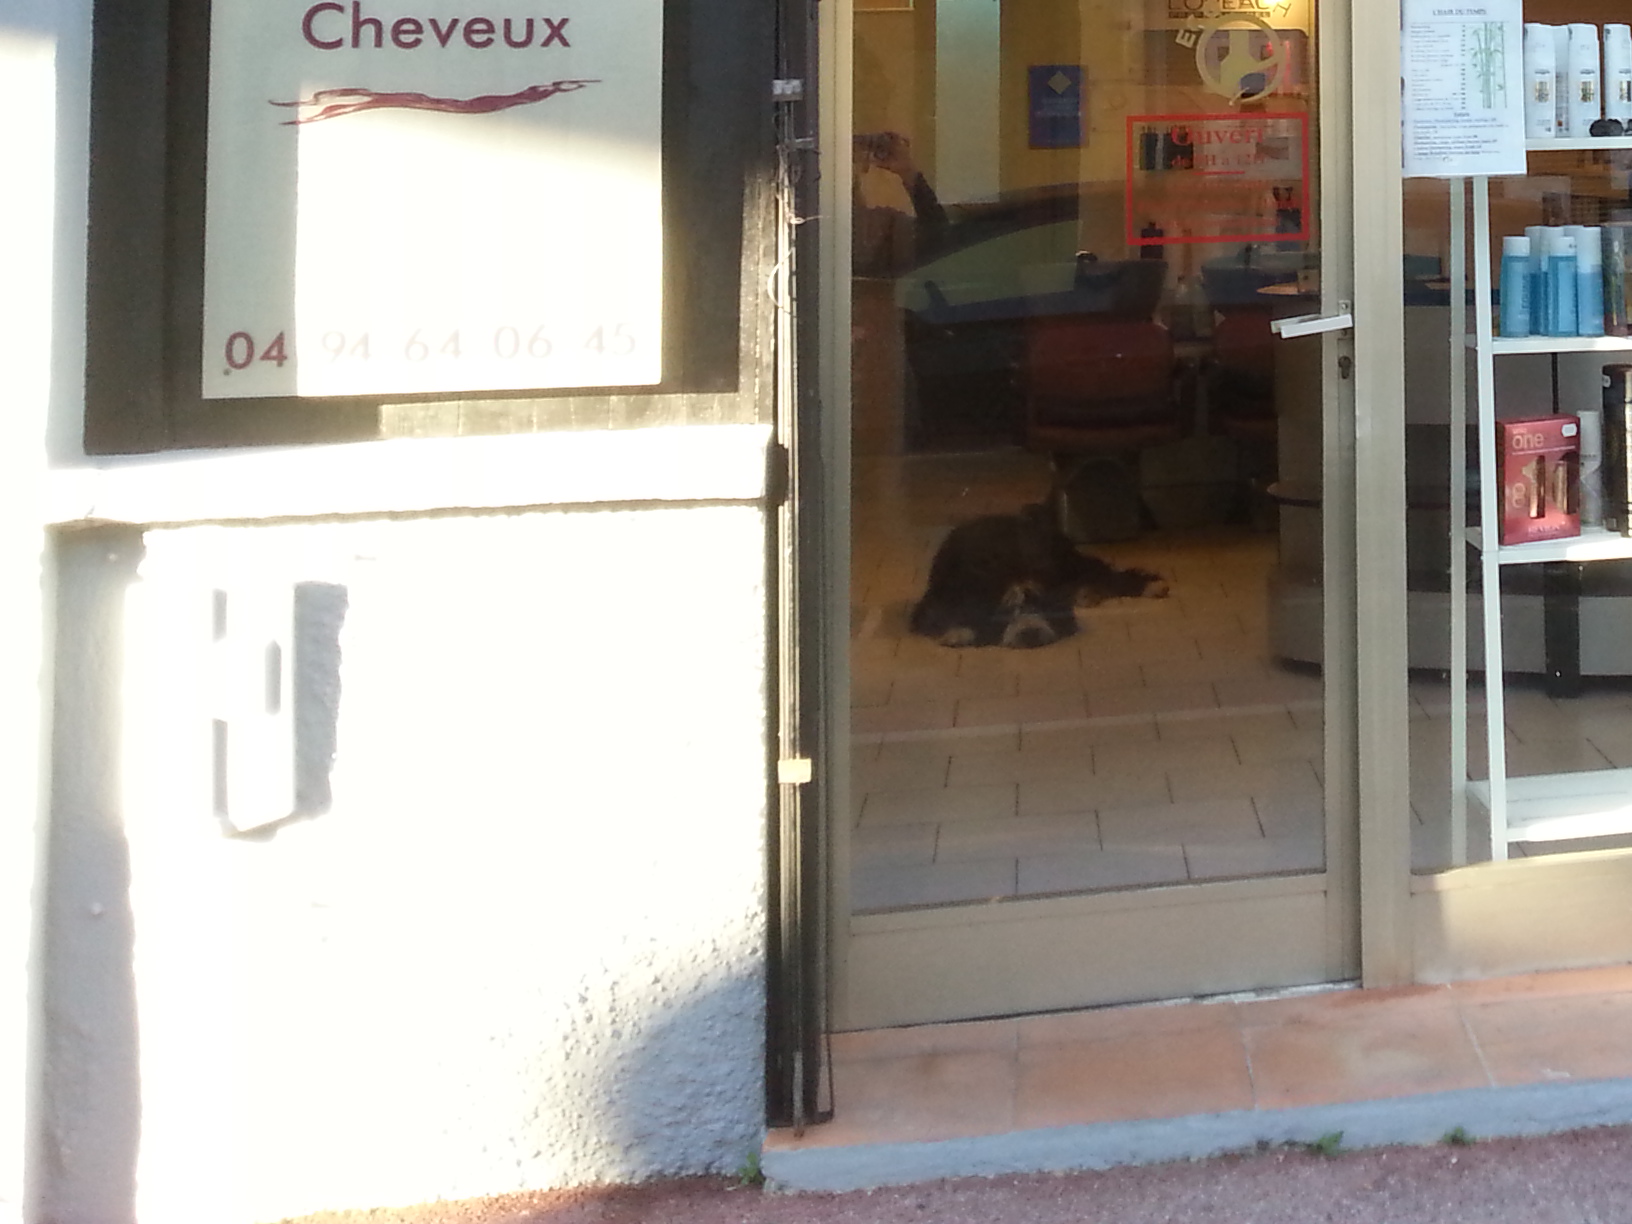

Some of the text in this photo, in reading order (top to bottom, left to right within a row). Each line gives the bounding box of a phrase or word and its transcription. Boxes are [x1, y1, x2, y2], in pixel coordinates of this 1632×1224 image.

[301, 0, 571, 50] Cheveux
[224, 322, 637, 370] 04 94 64 06 45
